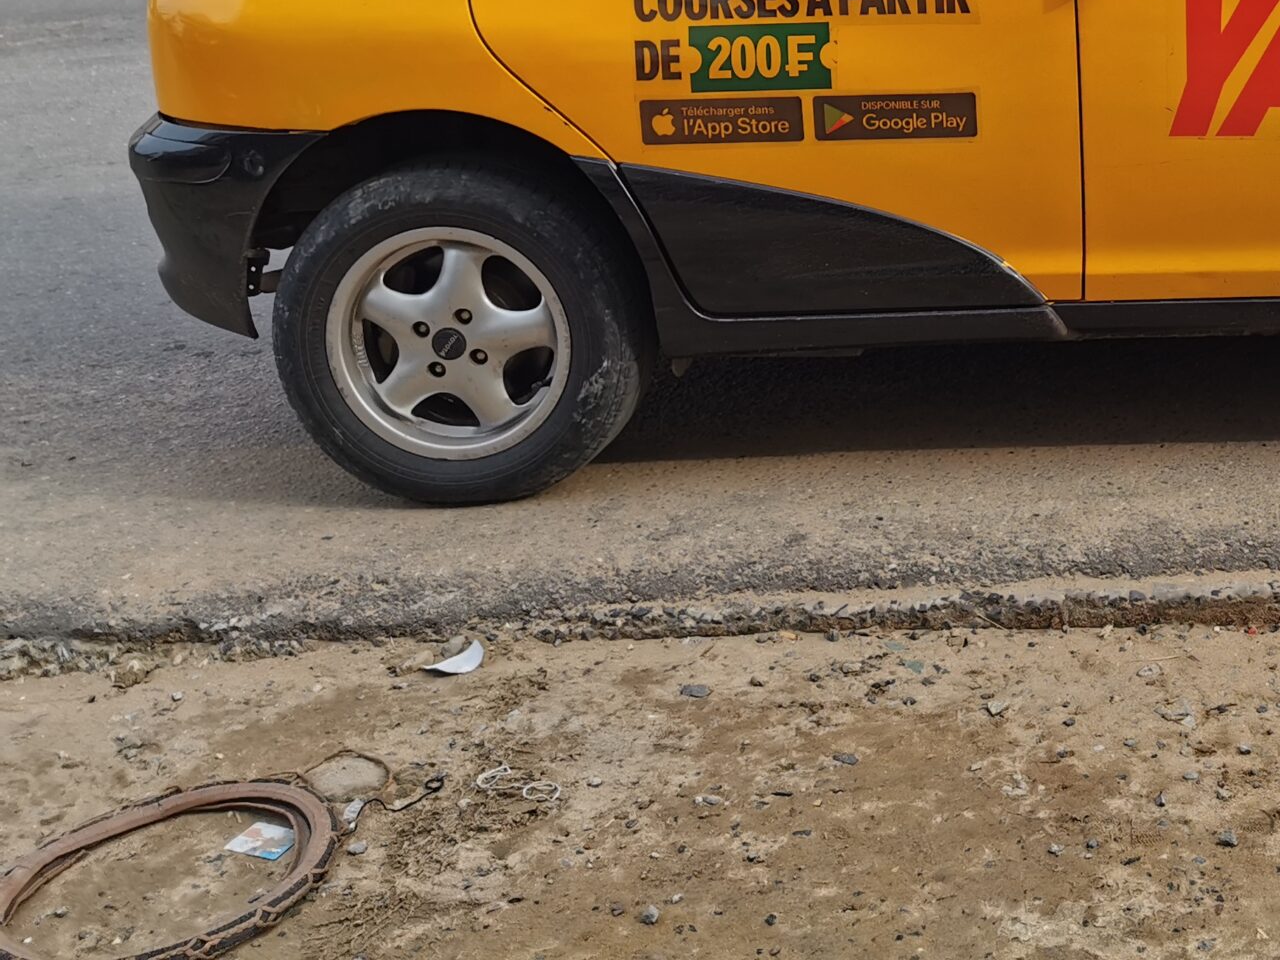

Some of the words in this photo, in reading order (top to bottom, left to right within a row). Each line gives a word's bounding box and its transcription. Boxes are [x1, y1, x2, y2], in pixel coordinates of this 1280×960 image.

[634, 39, 683, 81] DE
[680, 106, 745, 118] Télécharger
[747, 105, 775, 116] dans
[861, 100, 919, 111] DISPONIBLE
[920, 100, 941, 110] SUR
[683, 117, 733, 139] l'App
[737, 117, 790, 135] Store
[862, 112, 927, 133] Google
[930, 112, 967, 132] Play
[440, 334, 459, 357] TOYOTA
